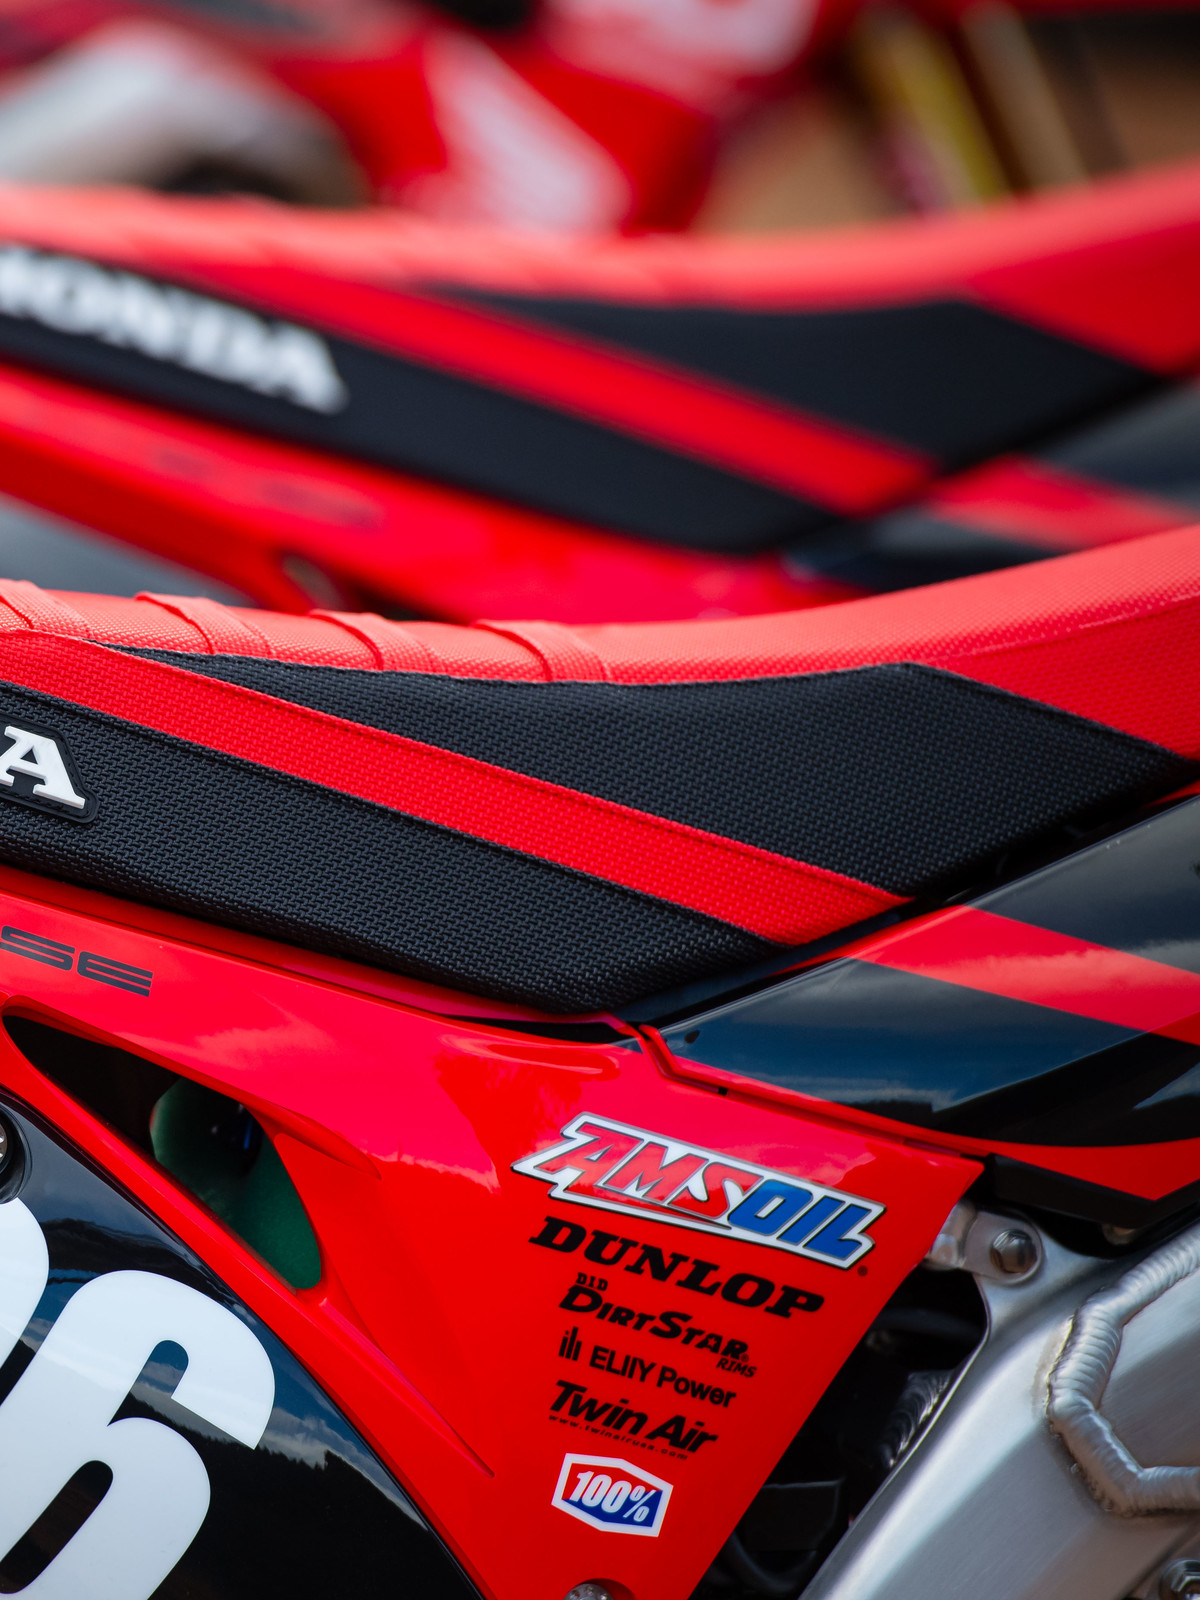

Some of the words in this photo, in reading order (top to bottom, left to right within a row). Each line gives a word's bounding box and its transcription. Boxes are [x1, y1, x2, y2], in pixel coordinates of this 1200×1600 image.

[533, 1121, 873, 1261] AMSOIL
[528, 1215, 826, 1319] DUNLOP
[576, 1272, 608, 1292] DID
[656, 1365, 737, 1408] Power
[716, 1357, 757, 1378] RIMS
[548, 1414, 688, 1461] www.twinairusa.com
[550, 1379, 649, 1436] Twin
[644, 1414, 719, 1453] Air
[569, 1470, 657, 1523] 100%
